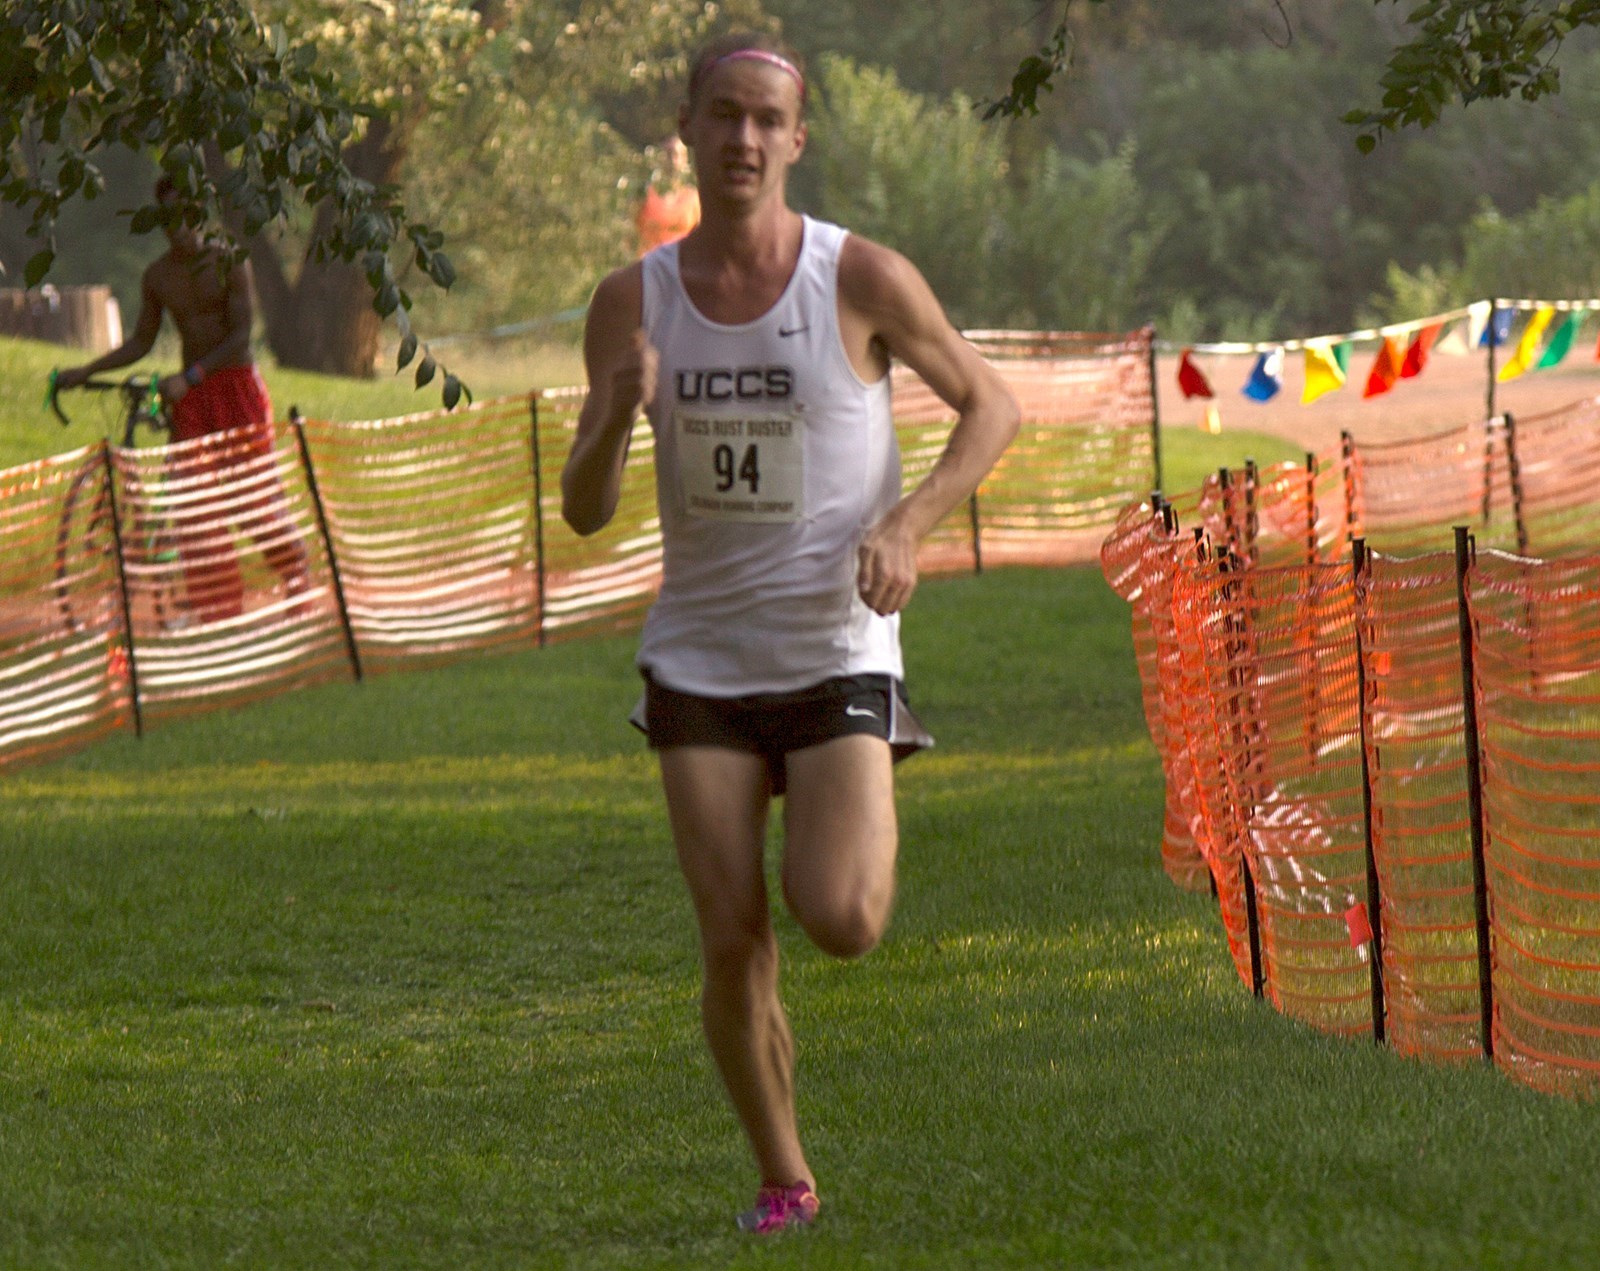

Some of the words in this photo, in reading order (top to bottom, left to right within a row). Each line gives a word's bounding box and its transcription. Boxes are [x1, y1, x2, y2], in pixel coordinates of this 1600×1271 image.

[676, 367, 793, 403] UCCS
[713, 420, 742, 436] RUST
[747, 420, 792, 437] BUSTER
[714, 443, 759, 493] 94
